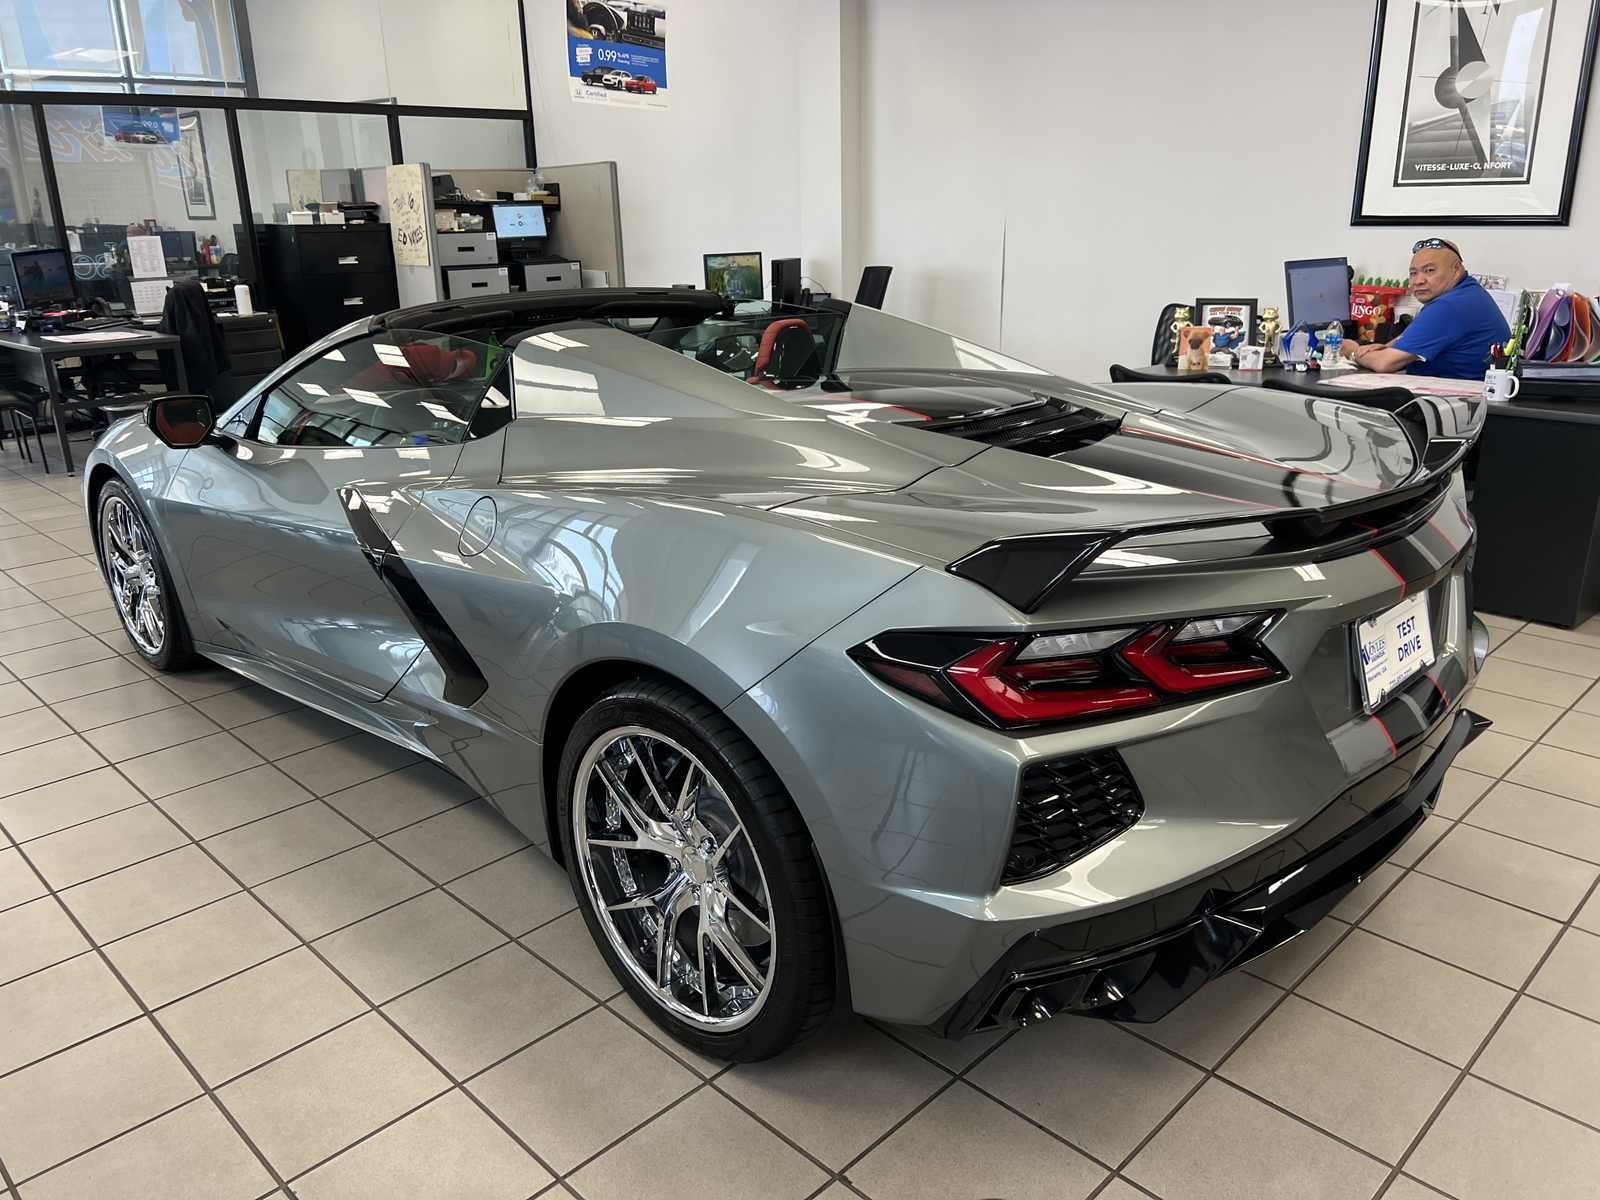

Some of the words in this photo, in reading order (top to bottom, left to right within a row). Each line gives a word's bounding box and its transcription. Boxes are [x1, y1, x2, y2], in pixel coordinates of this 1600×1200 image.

[597, 48, 617, 62] 0.99
[586, 90, 607, 98] Certified
[1351, 303, 1382, 318] LINGO
[1397, 616, 1415, 639] TEST
[1397, 634, 1422, 662] DRIVE
[1371, 651, 1386, 663] HONDA
